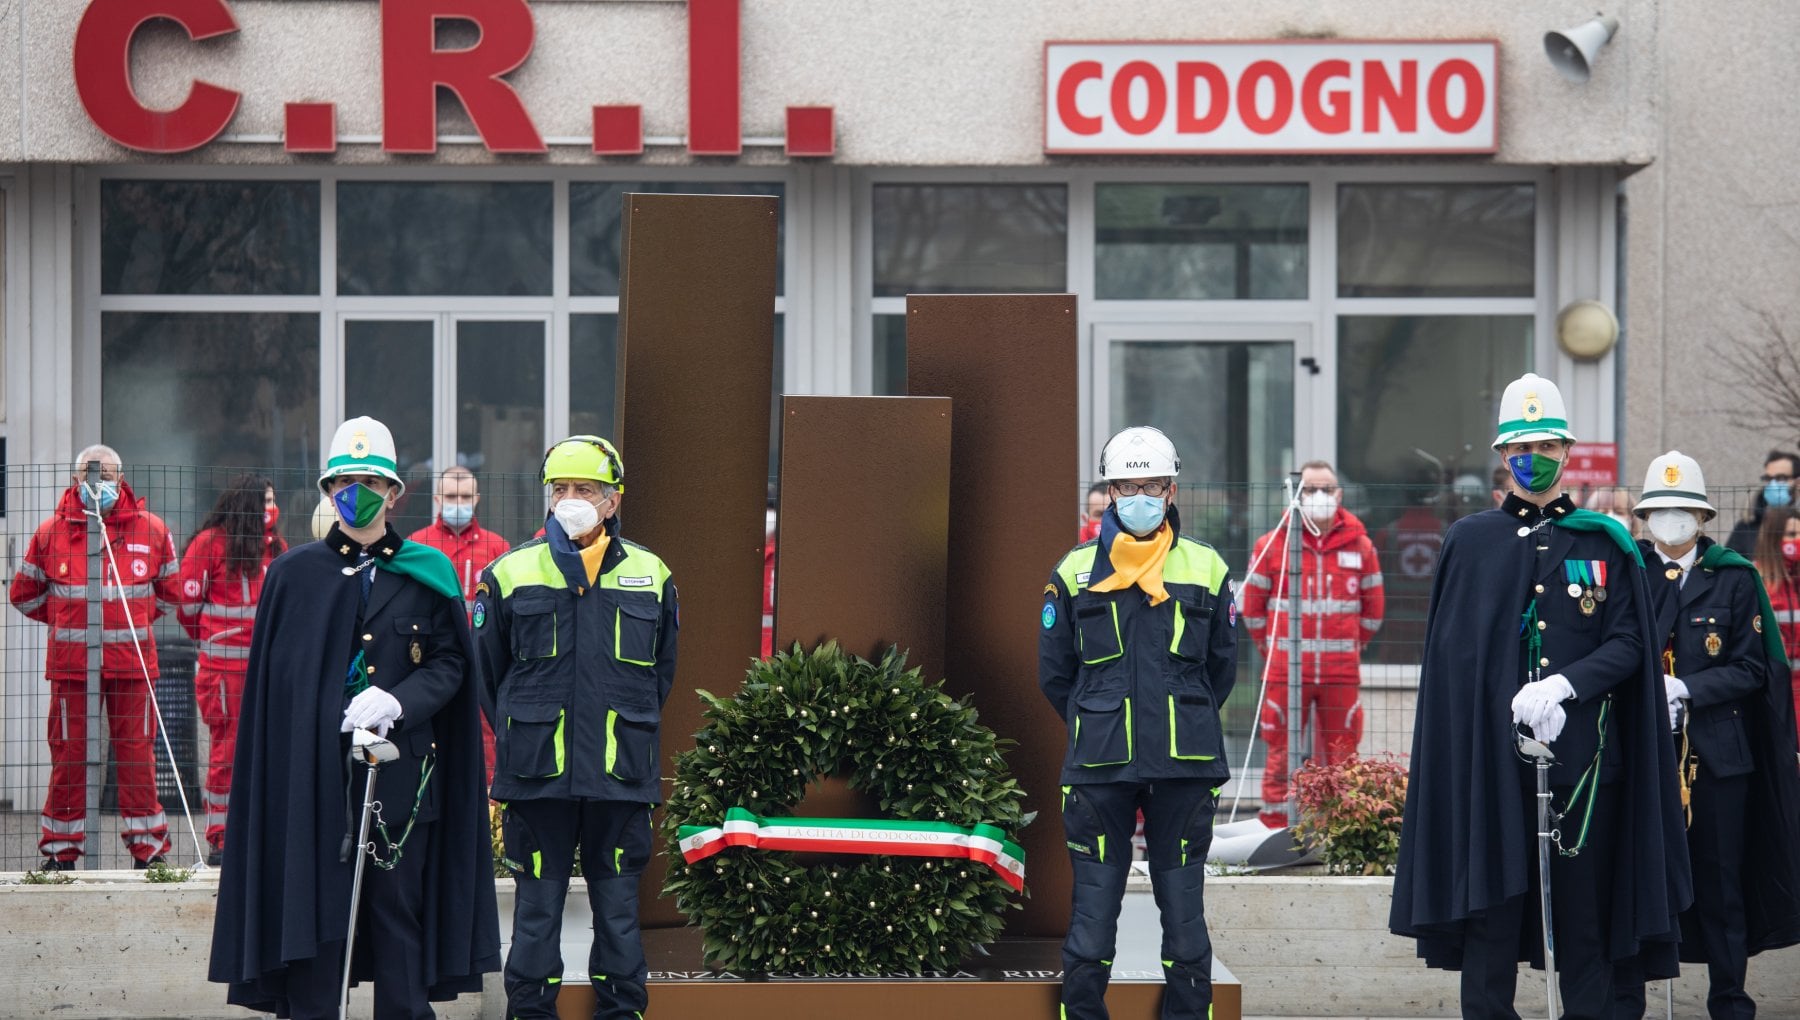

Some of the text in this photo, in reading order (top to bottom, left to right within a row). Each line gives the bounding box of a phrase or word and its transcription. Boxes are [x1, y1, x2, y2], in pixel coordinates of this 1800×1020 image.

[1056, 58, 1486, 135] CODOGNO
[1126, 461, 1150, 469] KASK
[787, 828, 803, 838] LA
[851, 830, 865, 839] DI
[869, 830, 939, 842] CODOGNO
